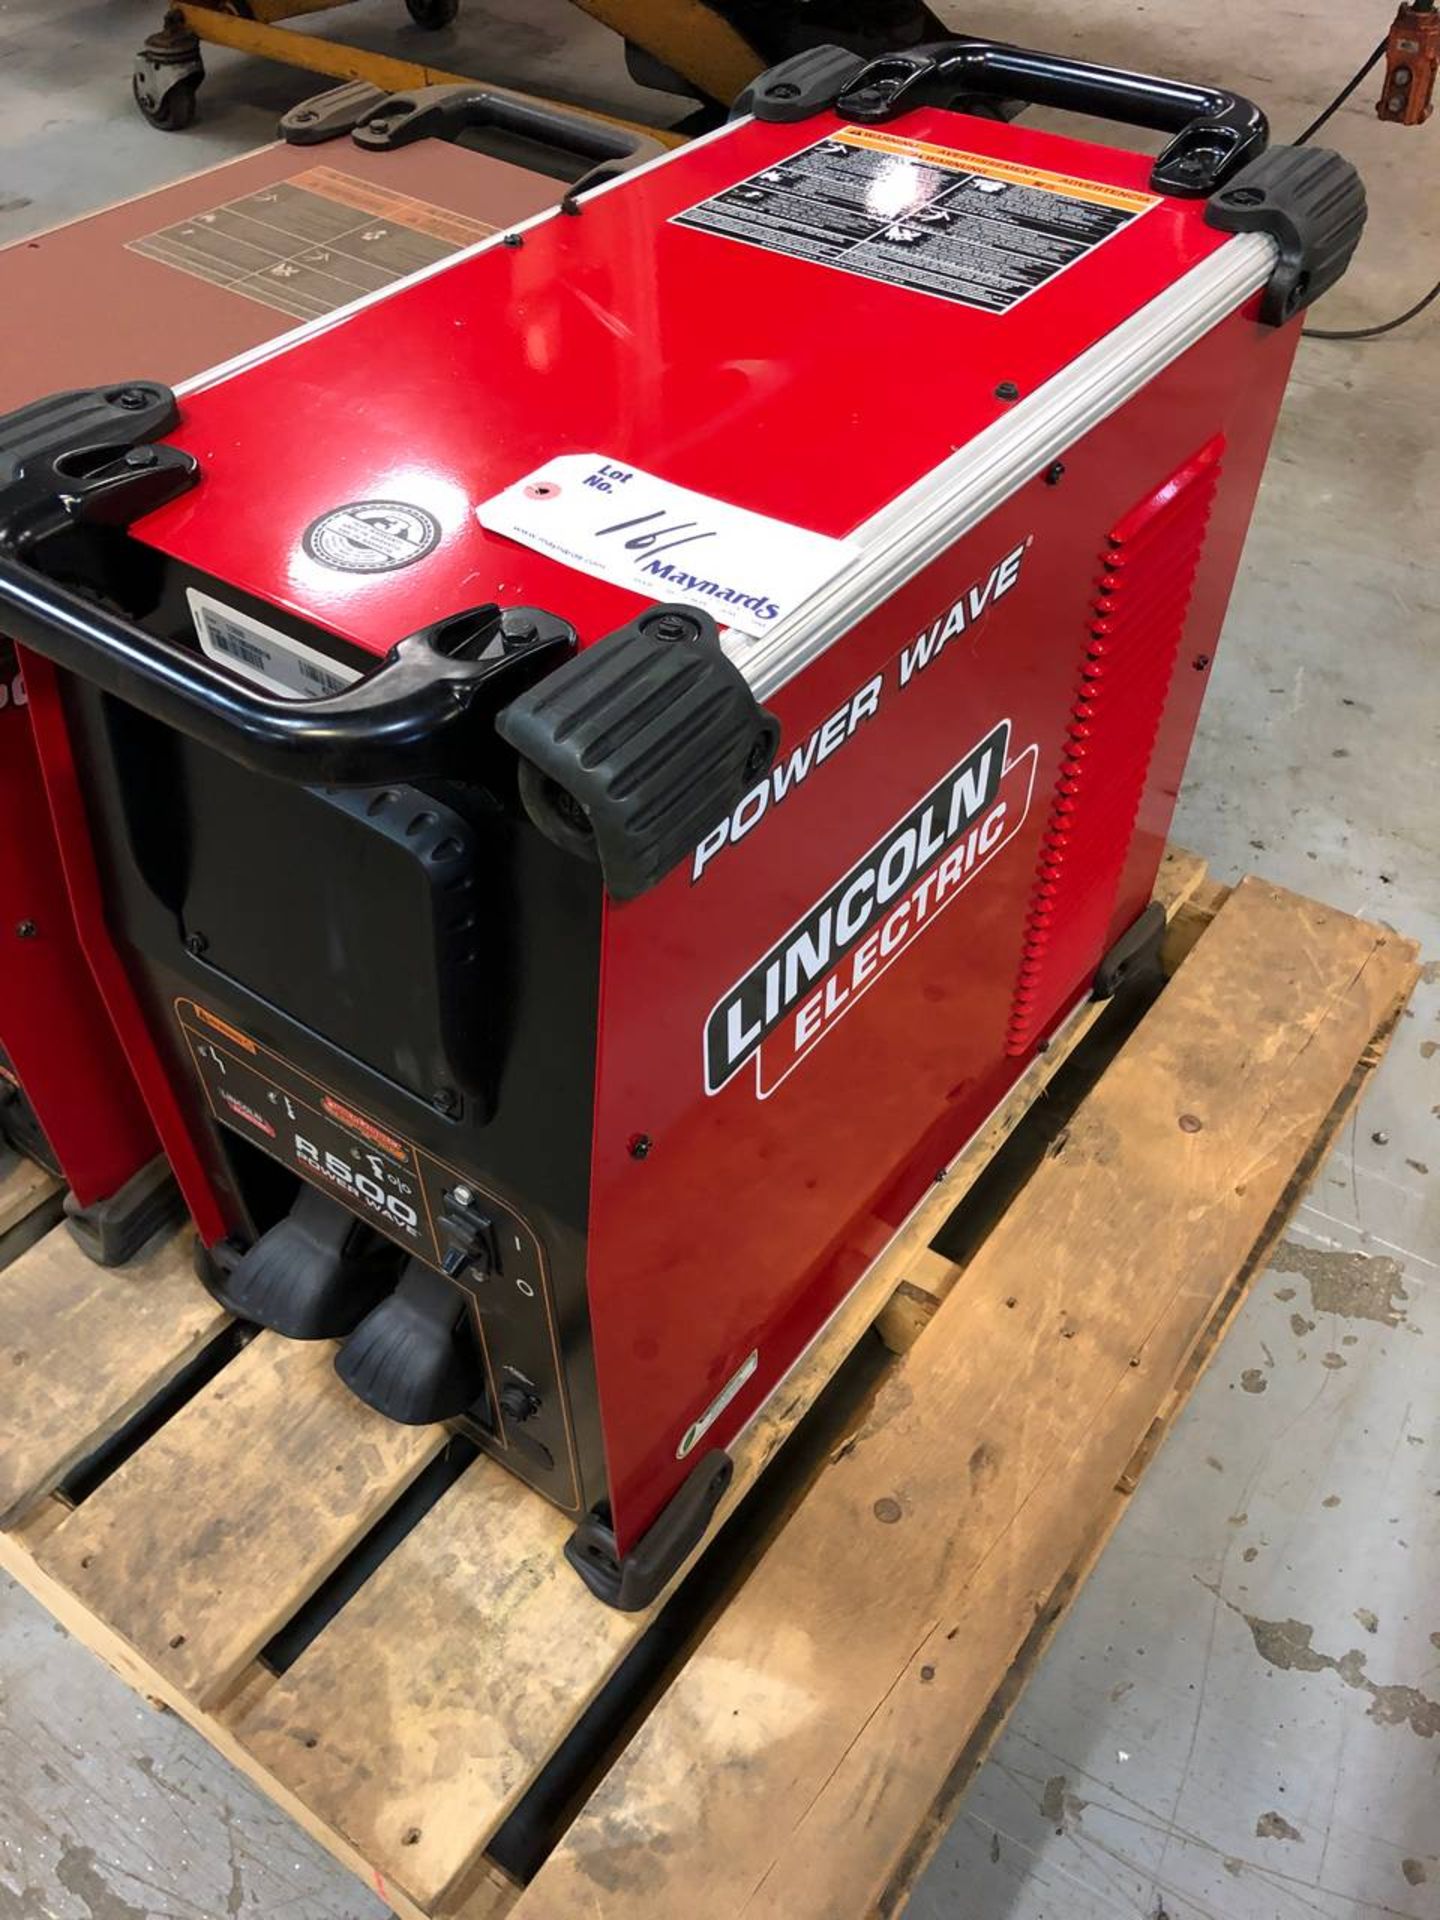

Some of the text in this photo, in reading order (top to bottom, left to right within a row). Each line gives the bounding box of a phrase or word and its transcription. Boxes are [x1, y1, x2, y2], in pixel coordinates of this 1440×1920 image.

[1057, 177, 1151, 203] ADVERTENCIA
[582, 474, 613, 494] No.
[597, 464, 633, 484] Lot
[642, 559, 781, 619] Maynards
[692, 544, 1025, 882] POWER WAVE
[727, 747, 993, 1065] LINCOLN
[795, 801, 1007, 1052] ELECTRIC
[295, 1133, 418, 1227] R500
[297, 1152, 418, 1238] POWER WAVE
